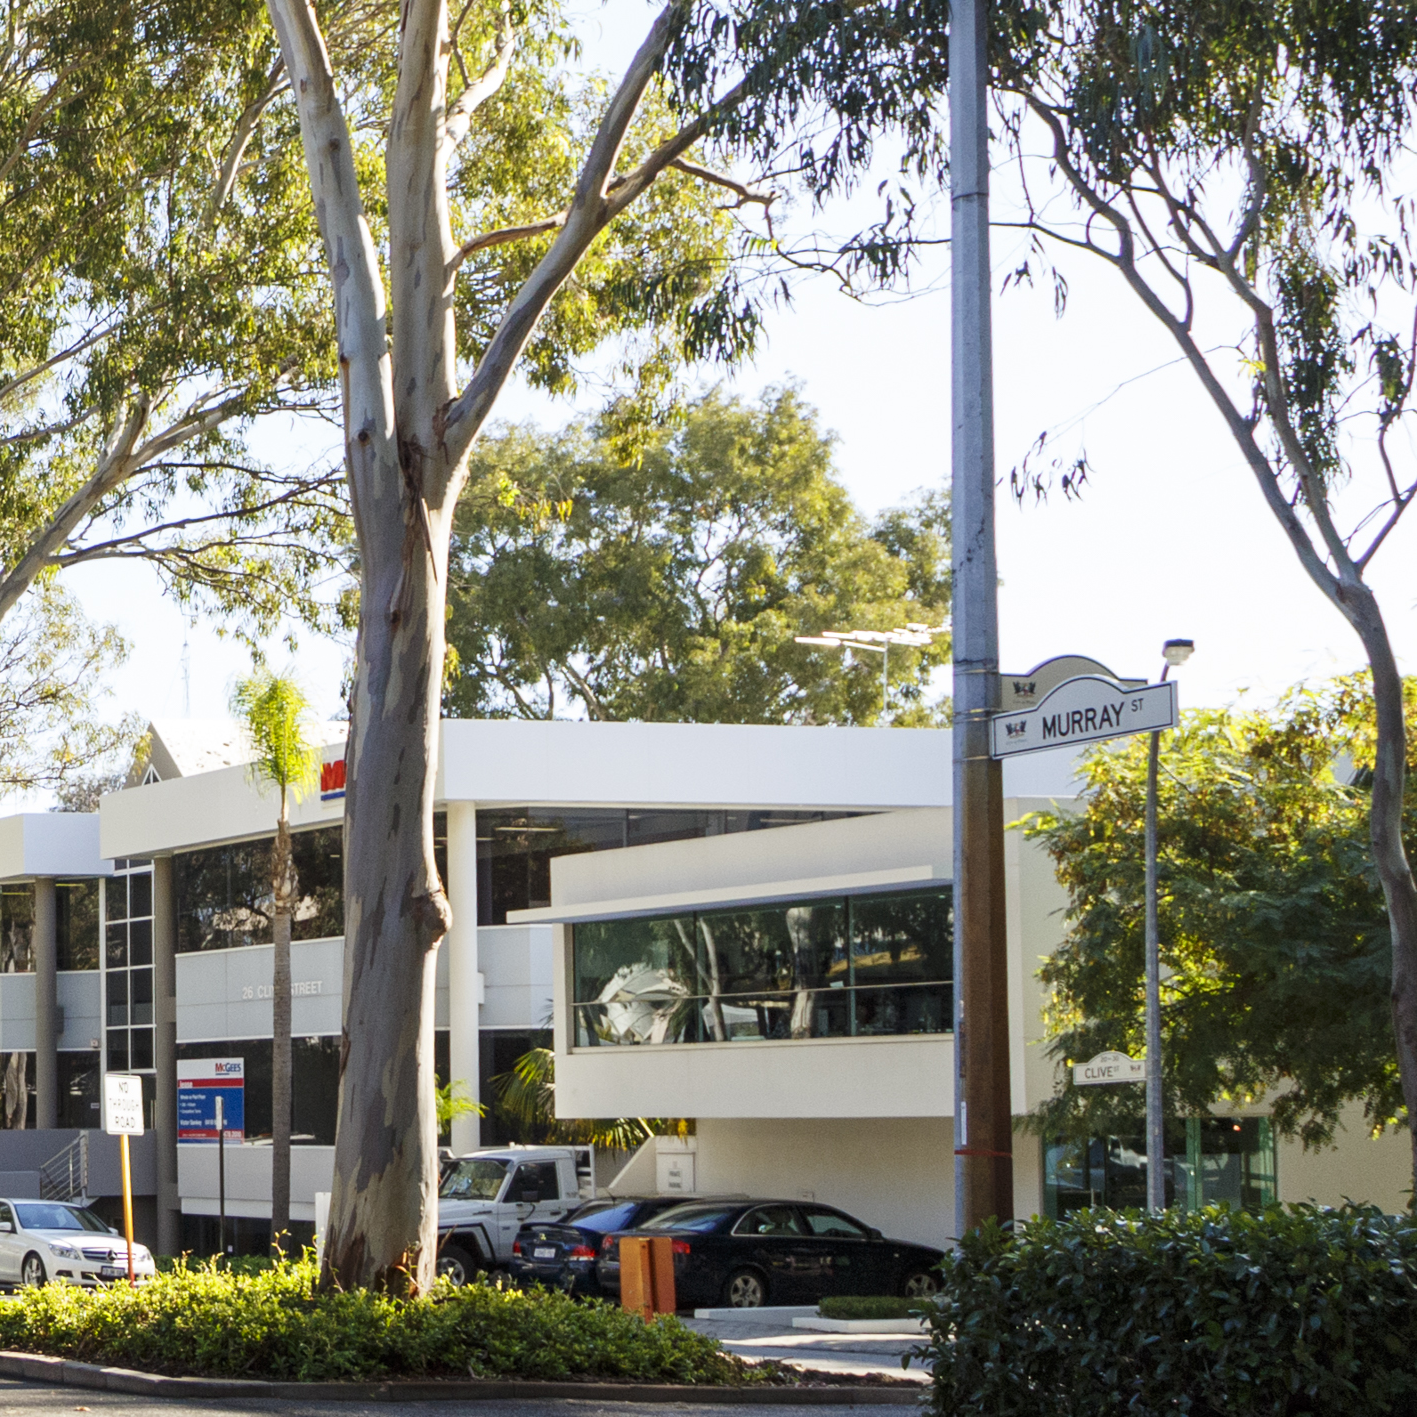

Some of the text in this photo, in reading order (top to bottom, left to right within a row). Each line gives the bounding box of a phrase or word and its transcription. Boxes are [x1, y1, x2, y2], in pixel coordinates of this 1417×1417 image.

[1041, 698, 1144, 740] MURRAY ST
[242, 986, 254, 999] 26
[1085, 1065, 1113, 1079] CLIVE
